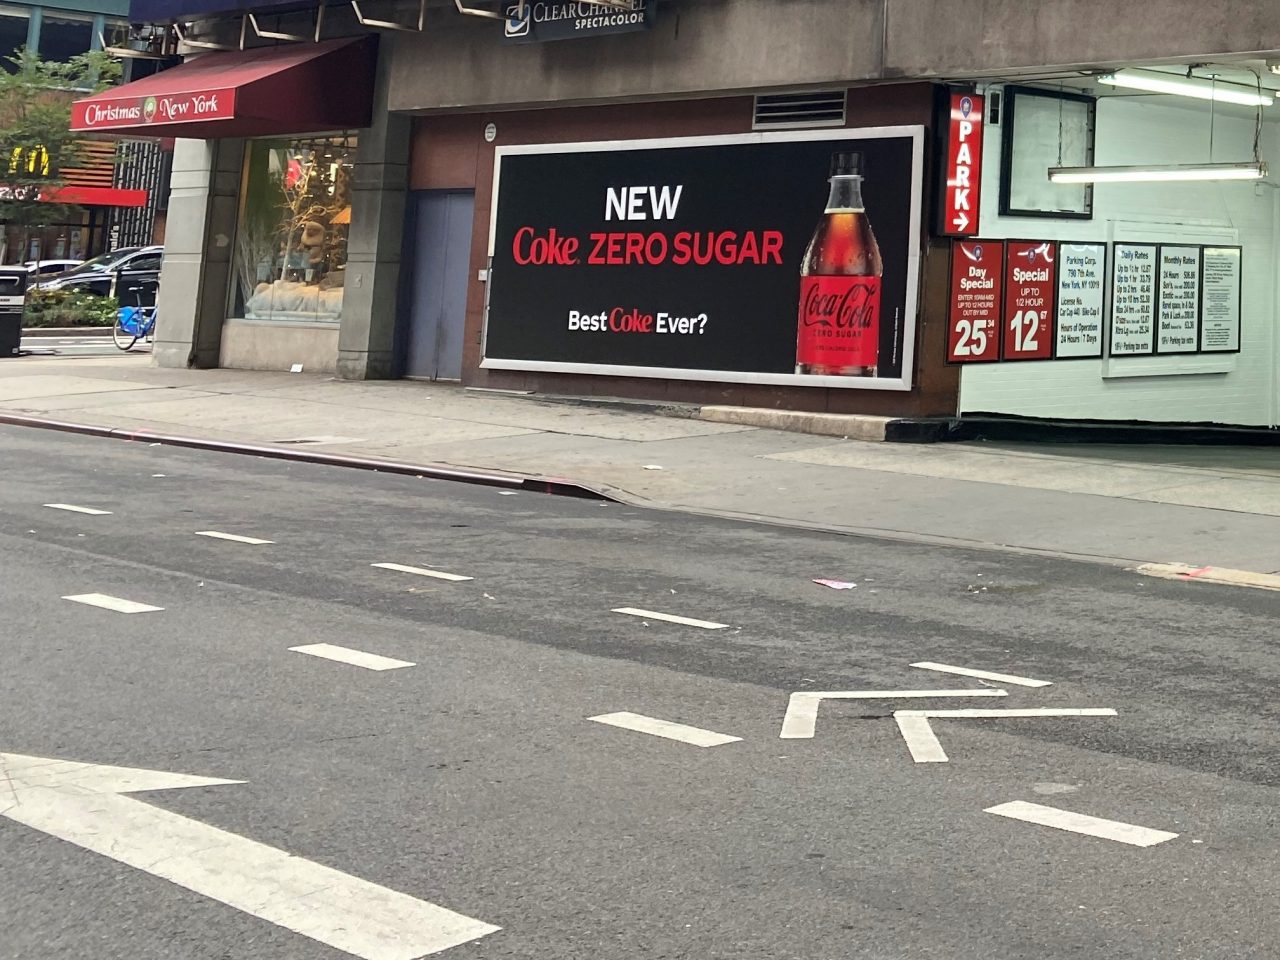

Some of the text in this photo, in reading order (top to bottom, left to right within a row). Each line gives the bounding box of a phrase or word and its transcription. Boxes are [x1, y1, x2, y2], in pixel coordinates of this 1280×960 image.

[575, 13, 644, 29] SPECTACOLOR
[85, 95, 217, 125] Christmas New York
[955, 120, 972, 210] PARK
[605, 185, 683, 221] NEW
[513, 226, 784, 265] Coke ZERO SUGAR
[1066, 256, 1084, 267] Parking
[1121, 251, 1148, 261] Daily Rates
[1164, 256, 1195, 266] Monthly Rates
[969, 266, 987, 279] Day
[1013, 267, 1049, 284] Special
[1077, 269, 1085, 277] 7th
[1085, 269, 1095, 277] Ave.
[960, 278, 994, 291] Special
[1062, 281, 1070, 289] New
[1082, 281, 1087, 289] NY
[1021, 288, 1040, 296] UP TO
[804, 283, 875, 328] Coca-Cola
[1016, 298, 1044, 307] 1/2 HOUR
[1061, 297, 1075, 305] License
[568, 307, 708, 334] Best Coke Ever?
[836, 330, 861, 338] SUGAR
[1010, 310, 1048, 351] 12 67
[1061, 323, 1097, 333] Hours of Operation
[953, 319, 995, 356] 25 34
[1061, 335, 1066, 343] 24
[1067, 335, 1079, 343] Hours
[1087, 334, 1097, 344] Days
